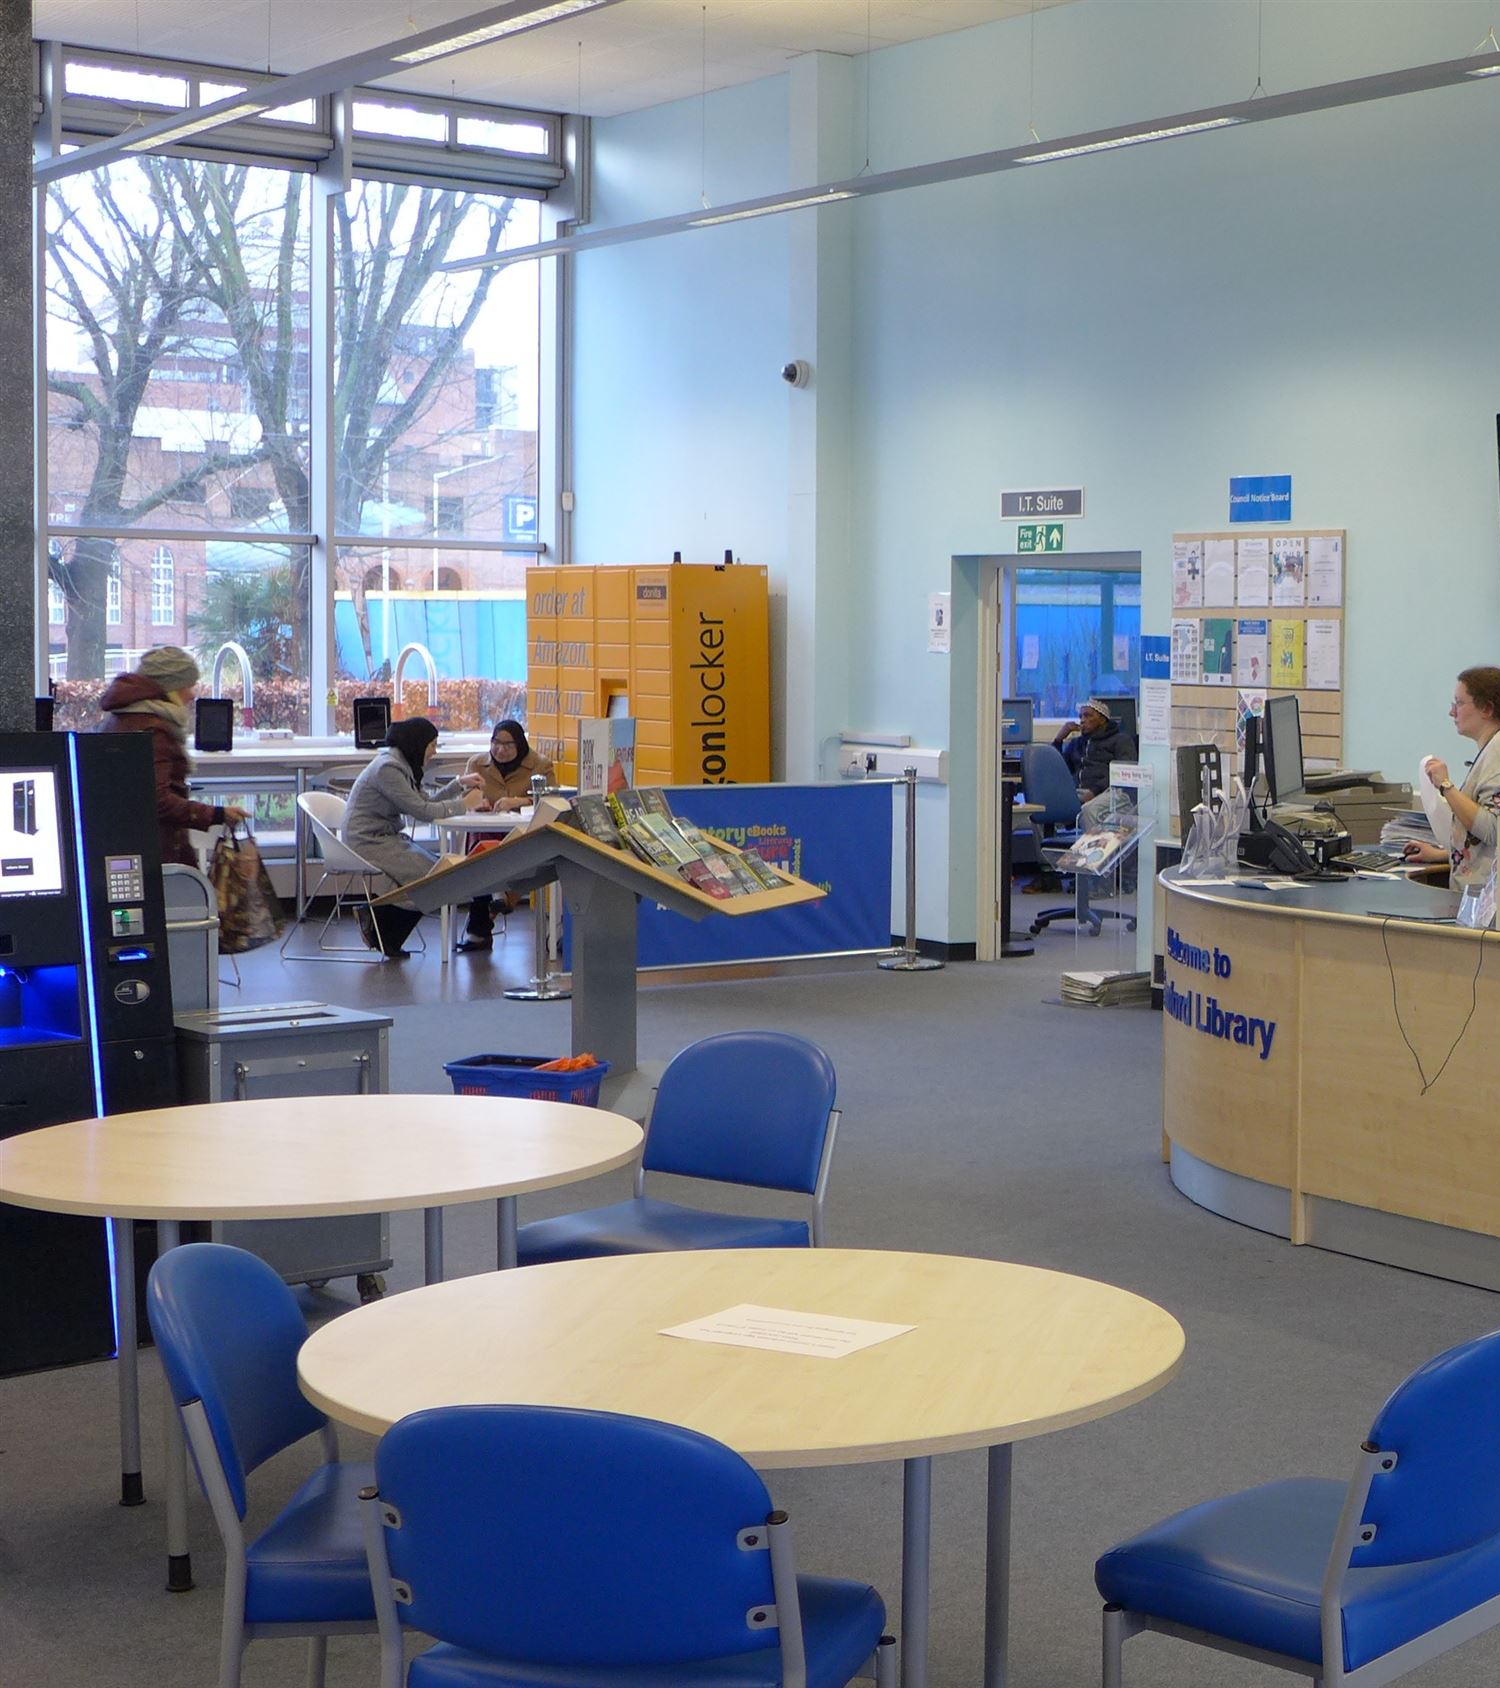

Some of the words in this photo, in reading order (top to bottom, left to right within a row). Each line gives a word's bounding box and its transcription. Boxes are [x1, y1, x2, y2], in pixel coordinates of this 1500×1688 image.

[1018, 495, 1034, 512] I.T.
[1036, 495, 1064, 512] Suite
[516, 504, 535, 527] P
[1019, 528, 1033, 539] Fire
[1019, 539, 1032, 550] exit
[533, 587, 568, 617] order
[571, 586, 586, 616] at
[1154, 653, 1170, 662] Suite
[535, 684, 561, 716] pick
[565, 691, 584, 720] up
[535, 733, 565, 762] here
[747, 823, 787, 838] eBooks
[1213, 946, 1232, 979] to
[1195, 992, 1277, 1061] Library
